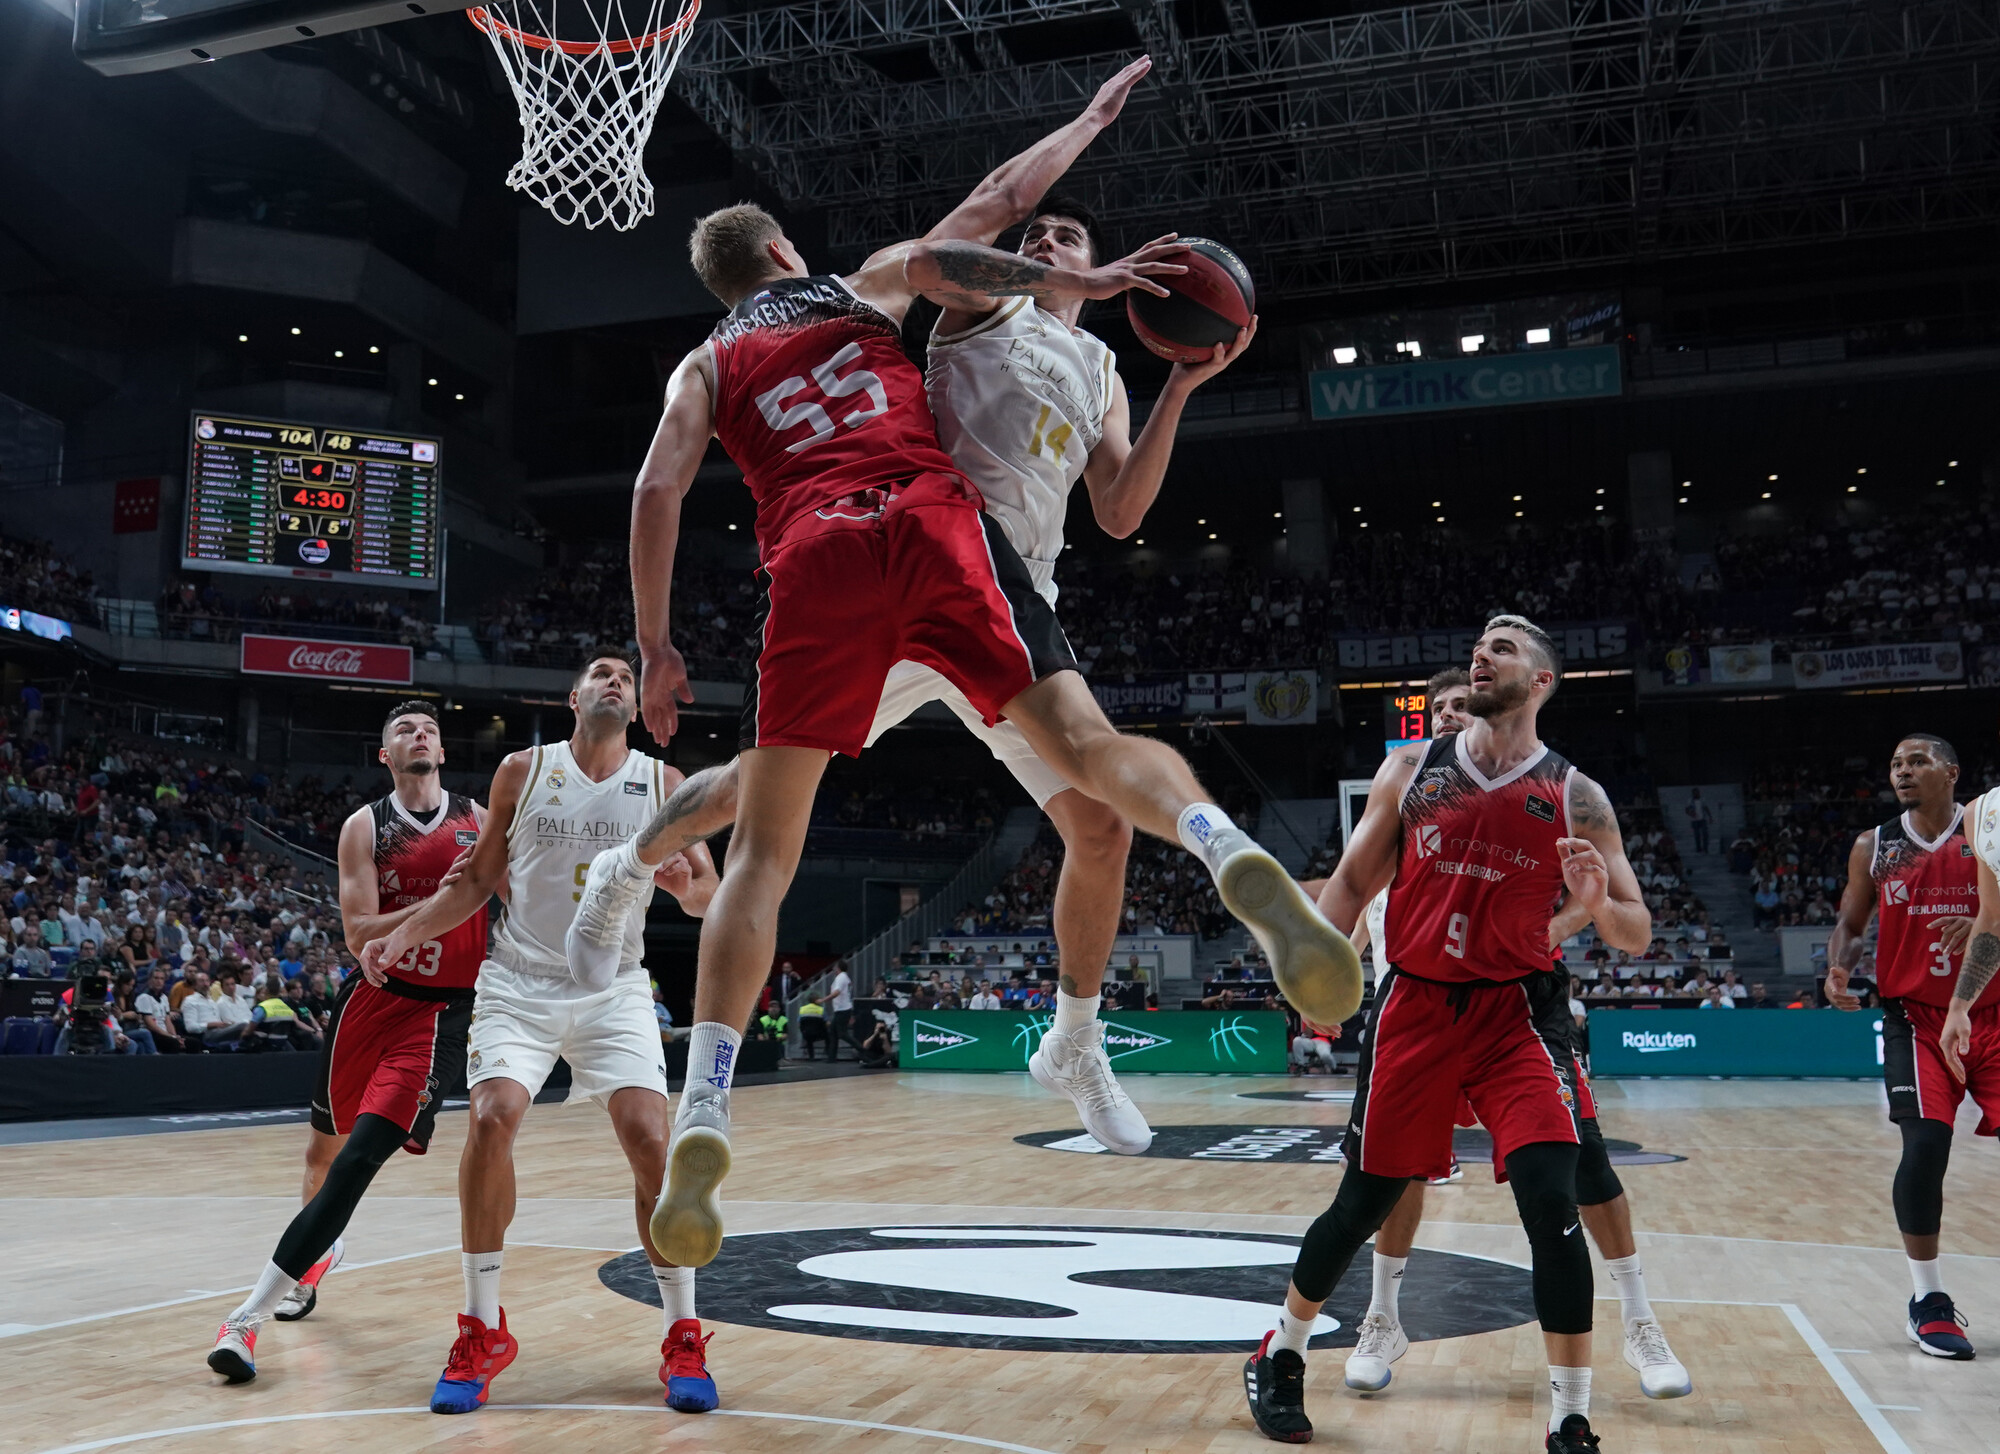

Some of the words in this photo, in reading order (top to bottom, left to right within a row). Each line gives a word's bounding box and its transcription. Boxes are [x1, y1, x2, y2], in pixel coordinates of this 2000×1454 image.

[754, 341, 889, 454] 55
[223, 427, 243, 437] REAL
[244, 429, 273, 439] MADRID
[279, 430, 313, 446] 104
[327, 434, 352, 450] 48
[1028, 403, 1074, 468] 14
[311, 463, 323, 476] 4
[293, 488, 346, 509] 4:30
[288, 516, 301, 531] 2
[1824, 653, 1845, 671] LOS
[1846, 650, 1875, 670] OJOS
[1876, 648, 1898, 668] DEL
[1394, 694, 1426, 712] 4:30
[1400, 713, 1424, 740] 13
[536, 839, 583, 851] HOTEL
[1907, 904, 1970, 916] FUENLABRADA
[1444, 912, 1469, 959] 9
[395, 939, 443, 977] 33
[1622, 1030, 1697, 1049] Rakuten
